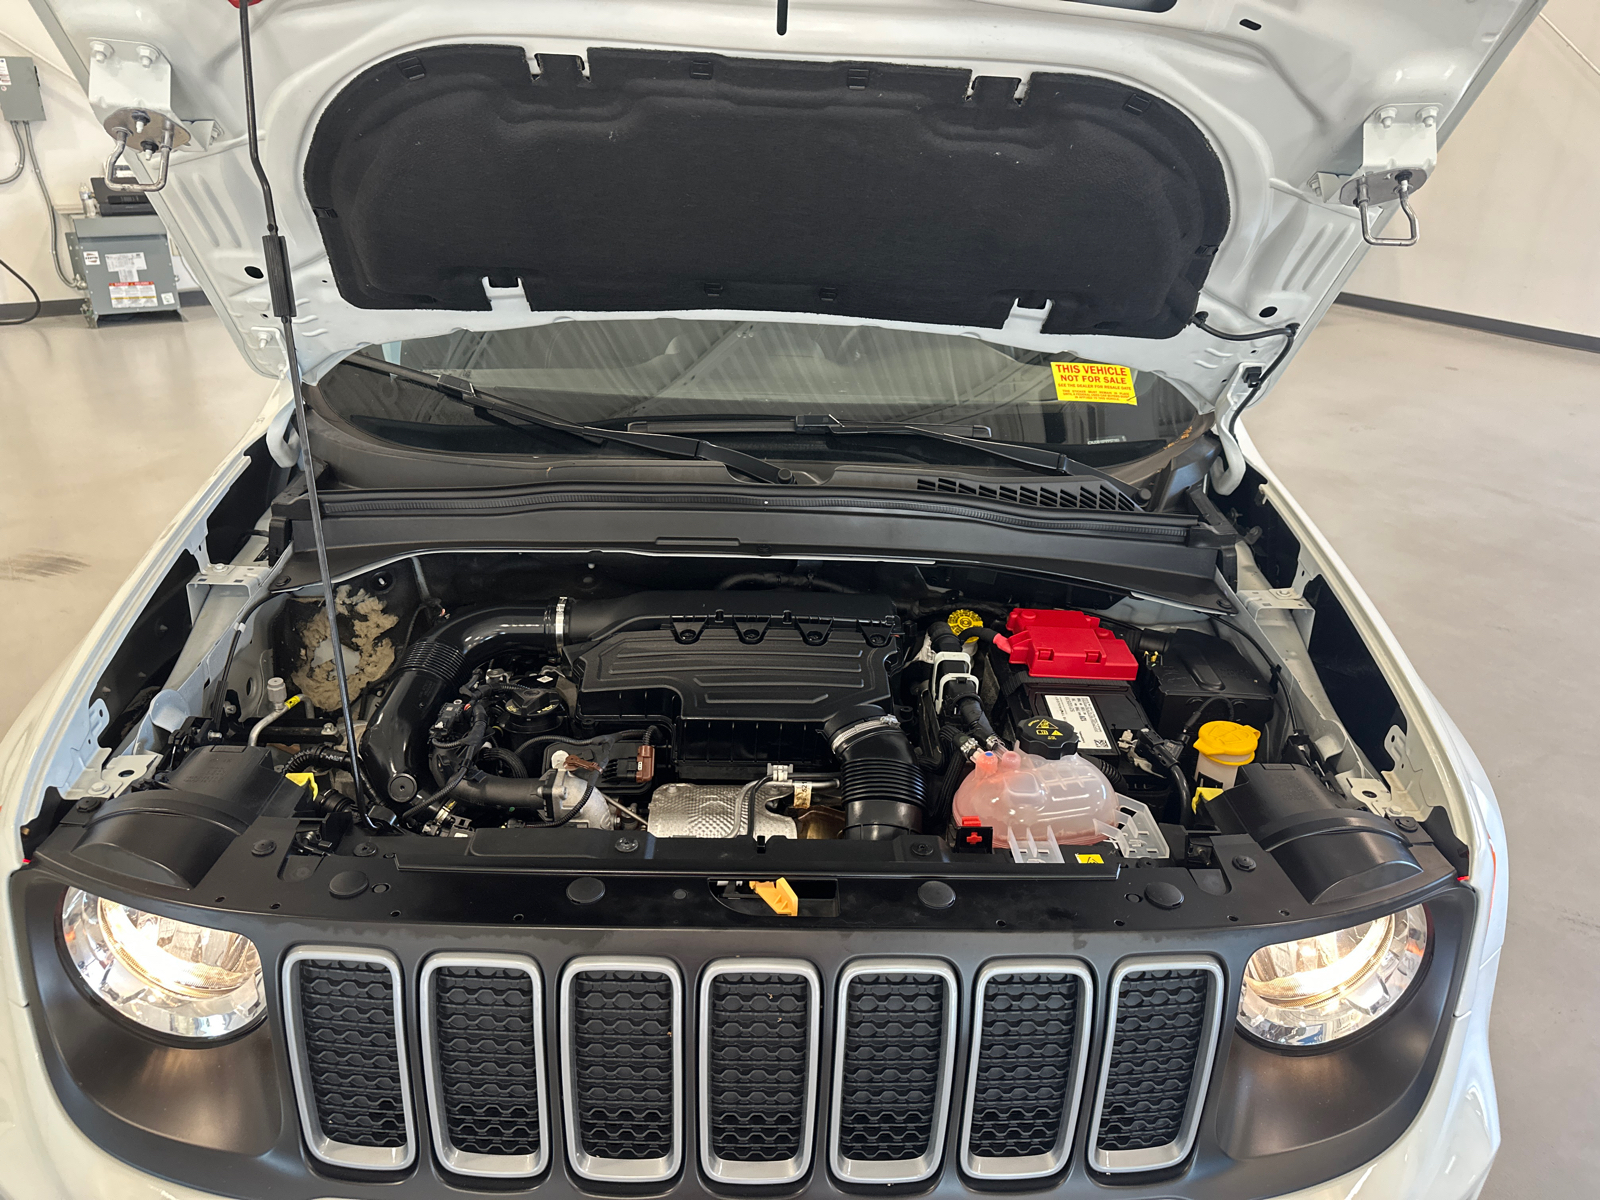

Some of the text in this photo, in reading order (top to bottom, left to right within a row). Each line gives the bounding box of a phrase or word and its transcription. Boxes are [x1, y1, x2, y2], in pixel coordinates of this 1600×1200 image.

[1055, 364, 1127, 376] THIS VEHICLE
[1060, 374, 1127, 385] NOT FOR SALE
